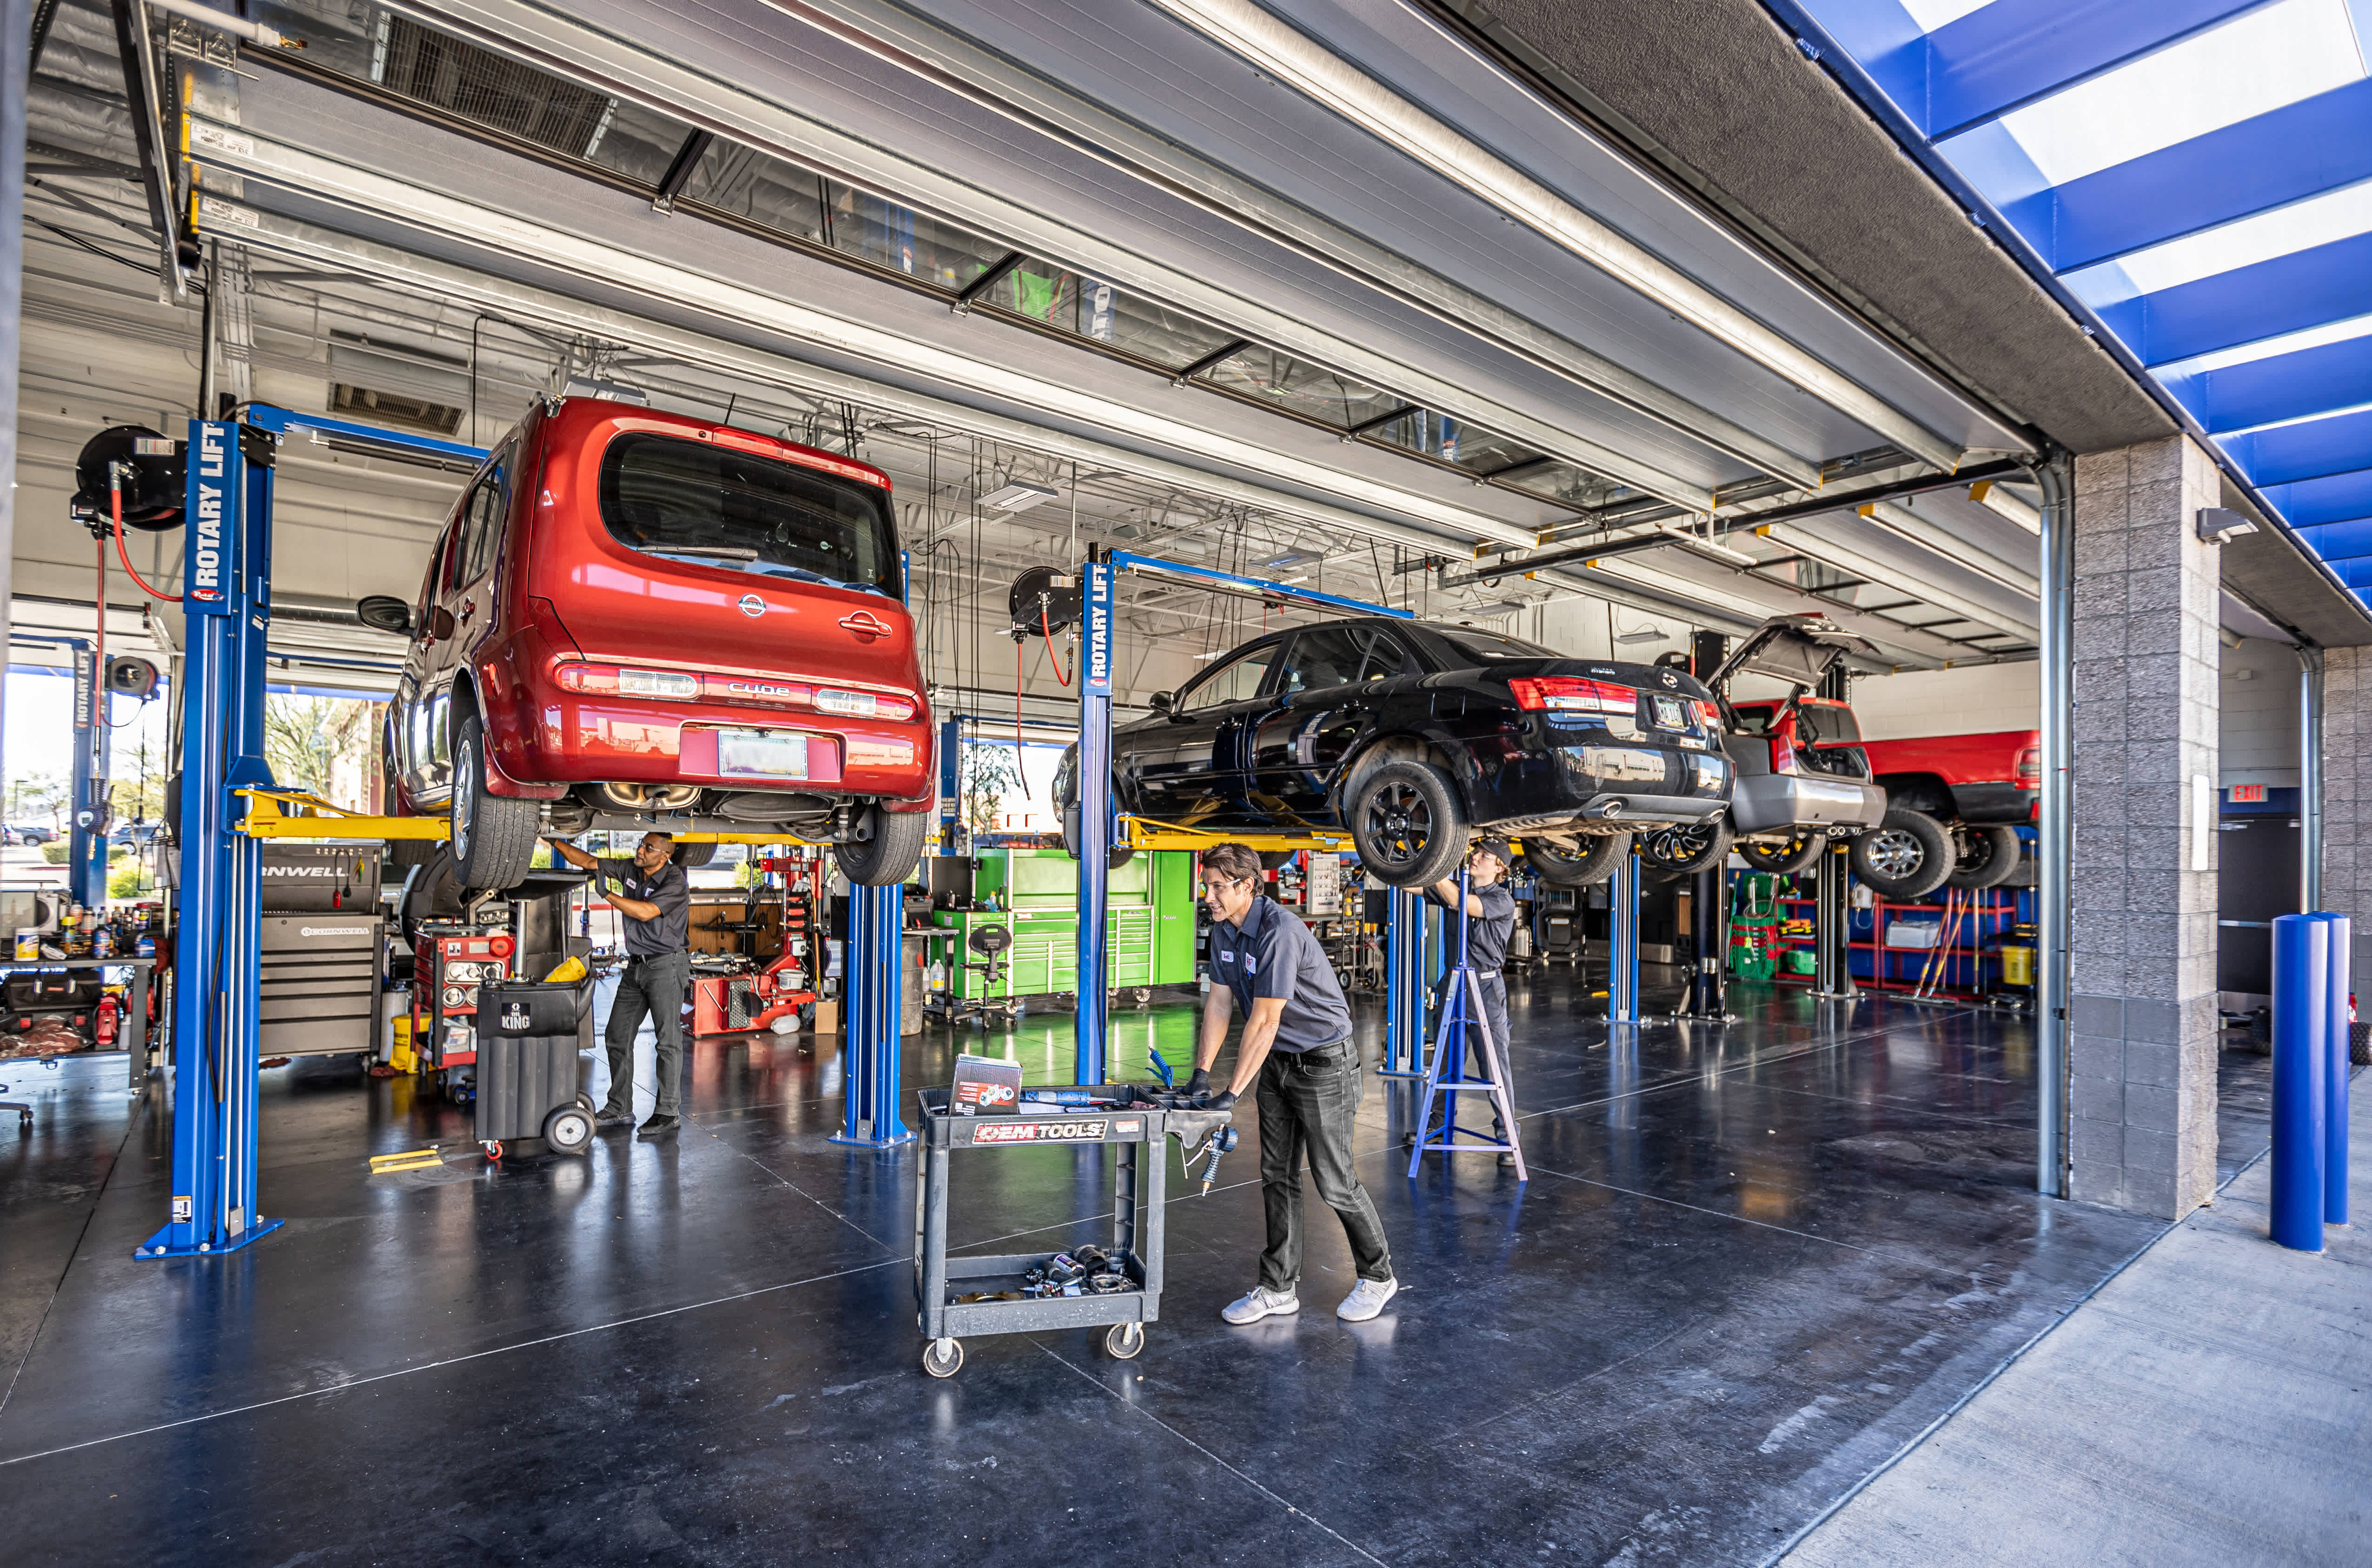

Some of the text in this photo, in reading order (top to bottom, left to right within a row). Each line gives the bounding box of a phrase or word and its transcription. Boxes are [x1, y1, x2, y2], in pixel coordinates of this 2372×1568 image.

[195, 422, 225, 587] ROTARY LIFT
[1091, 564, 1107, 677] ROTARY LIFT
[78, 652, 89, 674] LIFT
[729, 682, 790, 697] cube
[77, 677, 89, 721] ROTARY
[2235, 785, 2264, 801] EXIT
[262, 867, 346, 877] NWELL
[502, 1015, 530, 1030] KING
[1037, 1122, 1100, 1138] TOOLS
